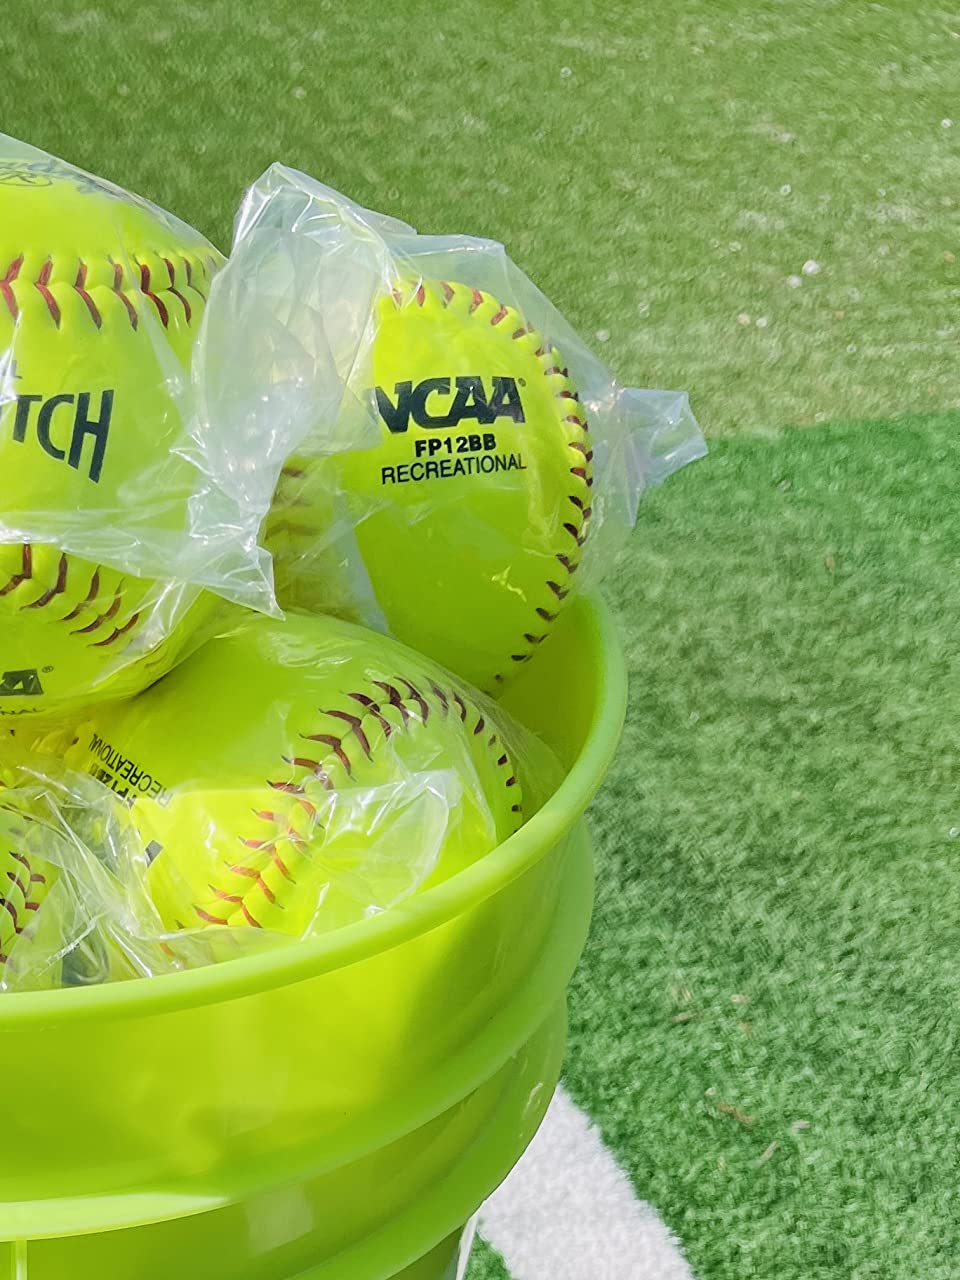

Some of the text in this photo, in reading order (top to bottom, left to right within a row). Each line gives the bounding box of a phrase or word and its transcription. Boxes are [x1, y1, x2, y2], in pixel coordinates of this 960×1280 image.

[371, 375, 527, 434] NCAA
[414, 433, 497, 458] FP12BB
[381, 452, 528, 485] RECREATIONAL
